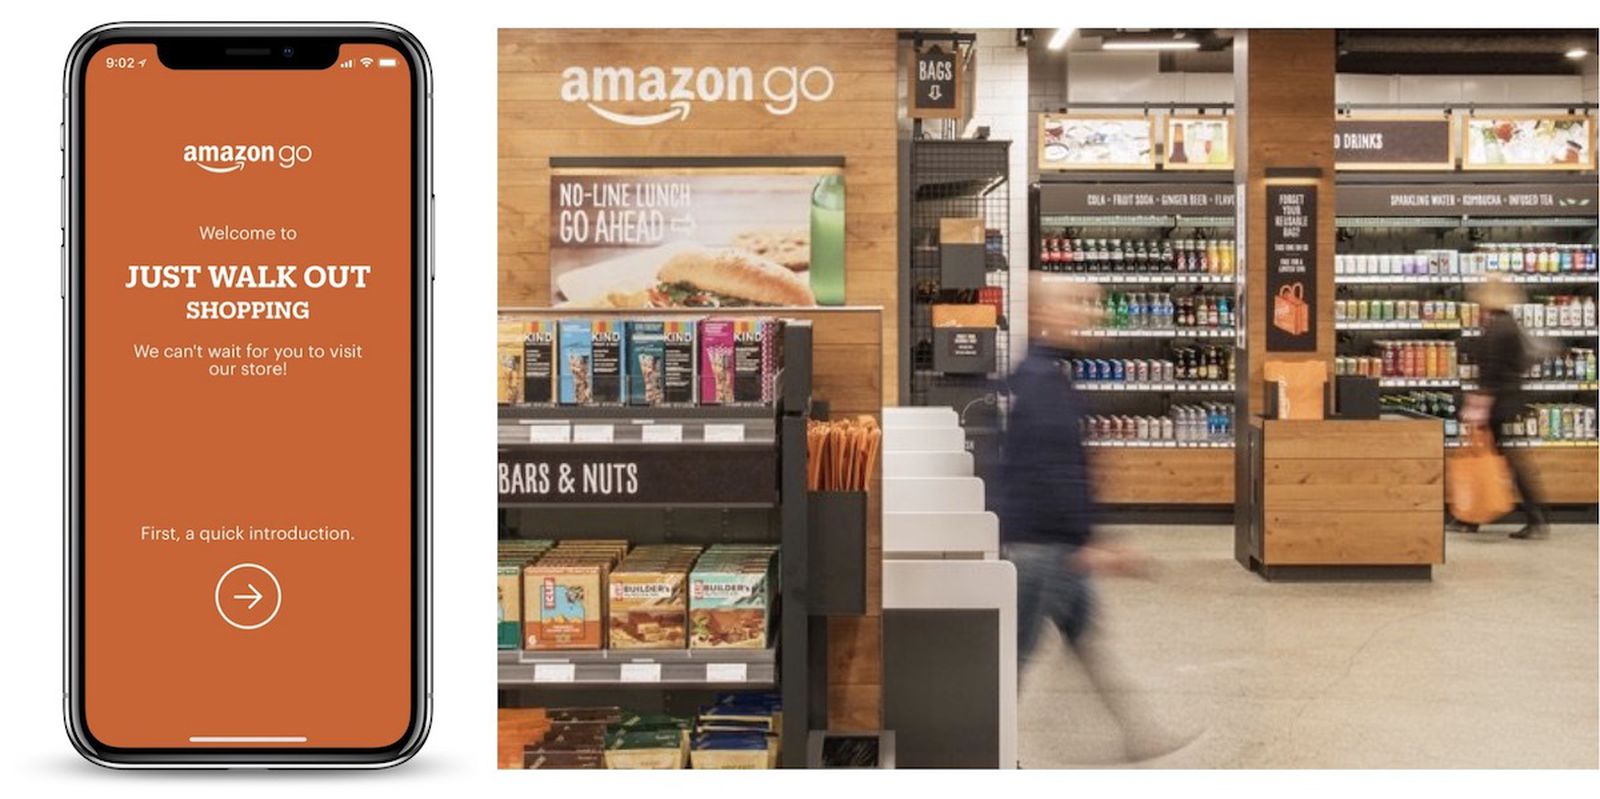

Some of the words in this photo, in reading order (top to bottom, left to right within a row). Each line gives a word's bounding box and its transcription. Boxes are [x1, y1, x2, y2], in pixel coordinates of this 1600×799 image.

[105, 57, 135, 69] 9:02
[919, 60, 952, 81] BAGS
[560, 66, 753, 106] amazon
[763, 66, 834, 115] go
[1343, 133, 1383, 149] DRINKS
[183, 144, 275, 165] amazon
[278, 144, 313, 169] go
[560, 183, 630, 208] NO-LINE
[636, 183, 691, 208] LUNCH
[199, 225, 276, 241] Welcome
[280, 227, 297, 241] to
[559, 210, 588, 243] GO
[595, 210, 664, 243] AHEAD
[125, 265, 202, 289] JUST
[208, 265, 298, 289] WALK
[303, 265, 372, 289] OUT
[186, 301, 310, 320] SHOPPING
[524, 332, 552, 342] KIND
[591, 332, 620, 342] KIND
[663, 332, 693, 342] KIND
[733, 332, 762, 342] KIND
[133, 344, 160, 359] We
[163, 344, 203, 359] can't
[207, 344, 242, 359] wait
[246, 343, 269, 359] for
[274, 347, 303, 363] you
[308, 345, 325, 359] to
[329, 344, 363, 359] visit
[208, 364, 236, 376] our
[240, 362, 287, 376] store!
[498, 462, 551, 495] BARS
[558, 463, 576, 494] &
[582, 462, 639, 494] NUTS
[141, 525, 181, 543] First,
[185, 529, 195, 541] a
[199, 526, 245, 545] quick
[249, 525, 355, 541] introduction.
